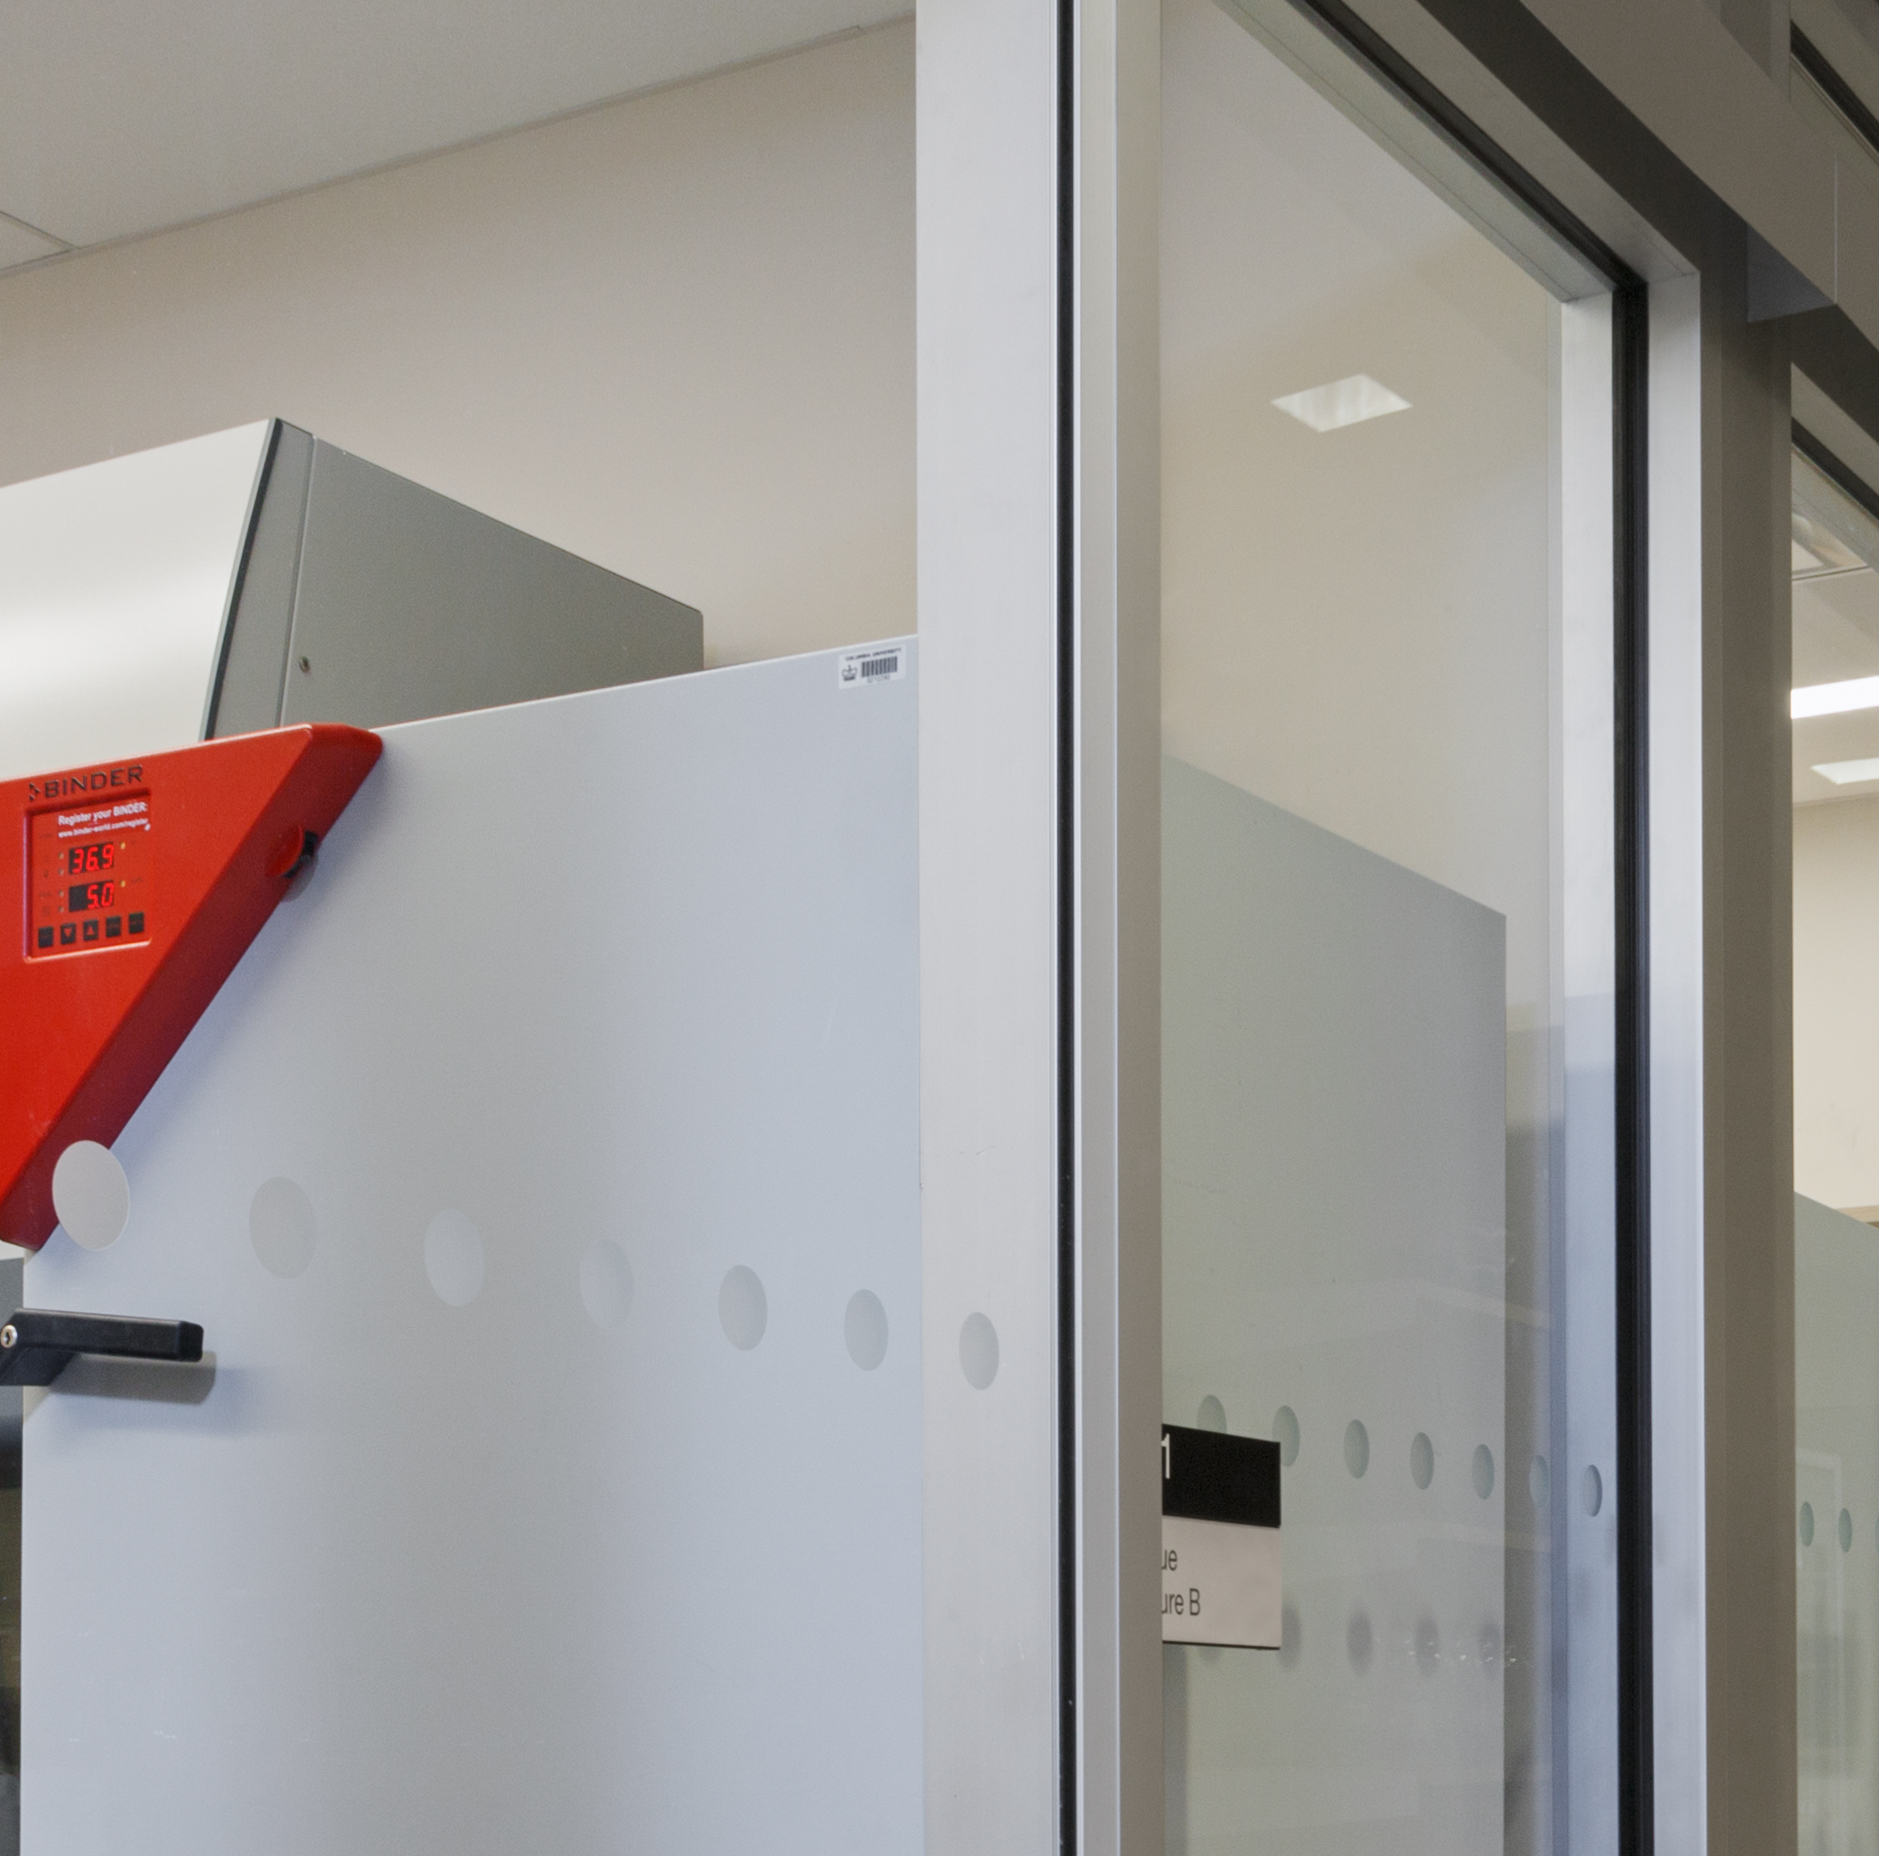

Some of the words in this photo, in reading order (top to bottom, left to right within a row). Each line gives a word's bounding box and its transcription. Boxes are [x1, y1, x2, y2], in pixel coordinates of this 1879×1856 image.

[44, 764, 144, 798] BINDER
[58, 811, 92, 827] Register
[93, 809, 112, 824] your
[1189, 1588, 1201, 1616] B
